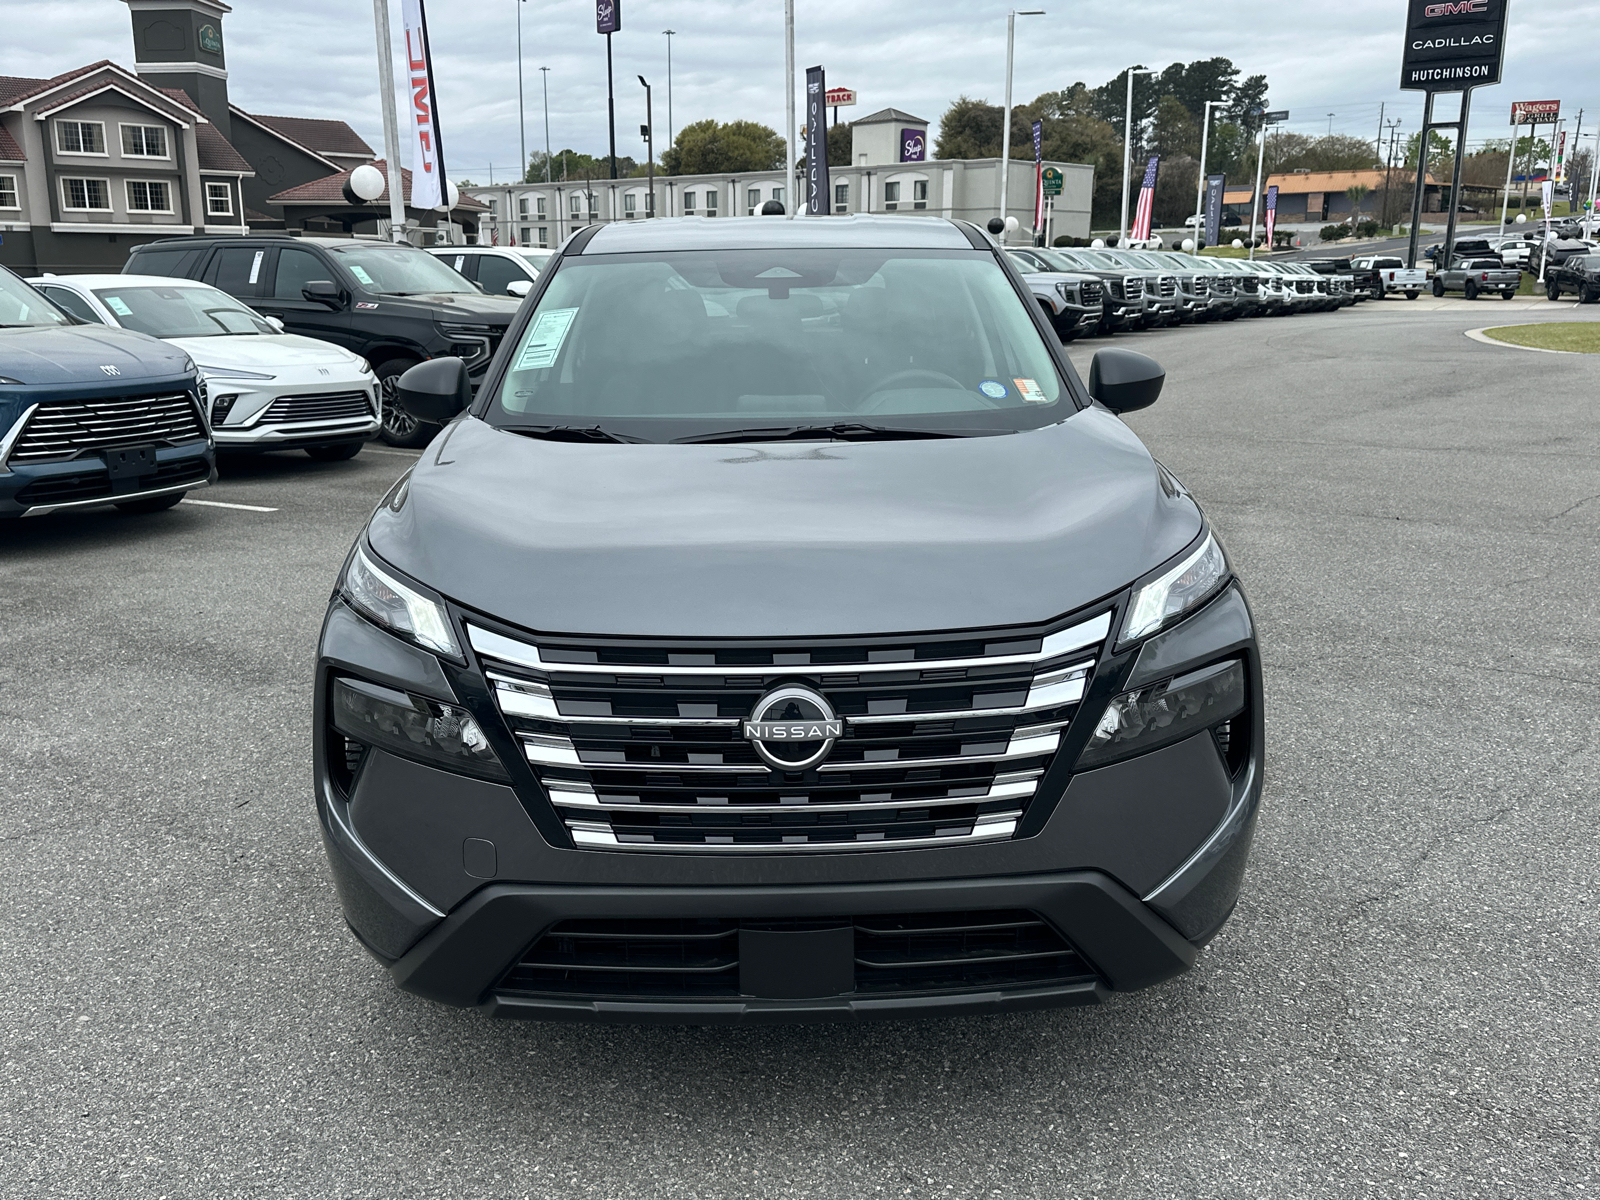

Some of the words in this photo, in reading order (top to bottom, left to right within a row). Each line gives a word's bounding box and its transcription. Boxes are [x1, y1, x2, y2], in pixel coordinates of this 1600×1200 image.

[1425, 0, 1488, 17] GMC
[1412, 35, 1494, 49] CADILLAC
[1411, 65, 1489, 81] HUTCHINSON
[826, 94, 852, 103] TBACK
[1515, 102, 1558, 113] Wagers
[905, 139, 921, 156] Sleep
[746, 723, 840, 738] NISSAN
